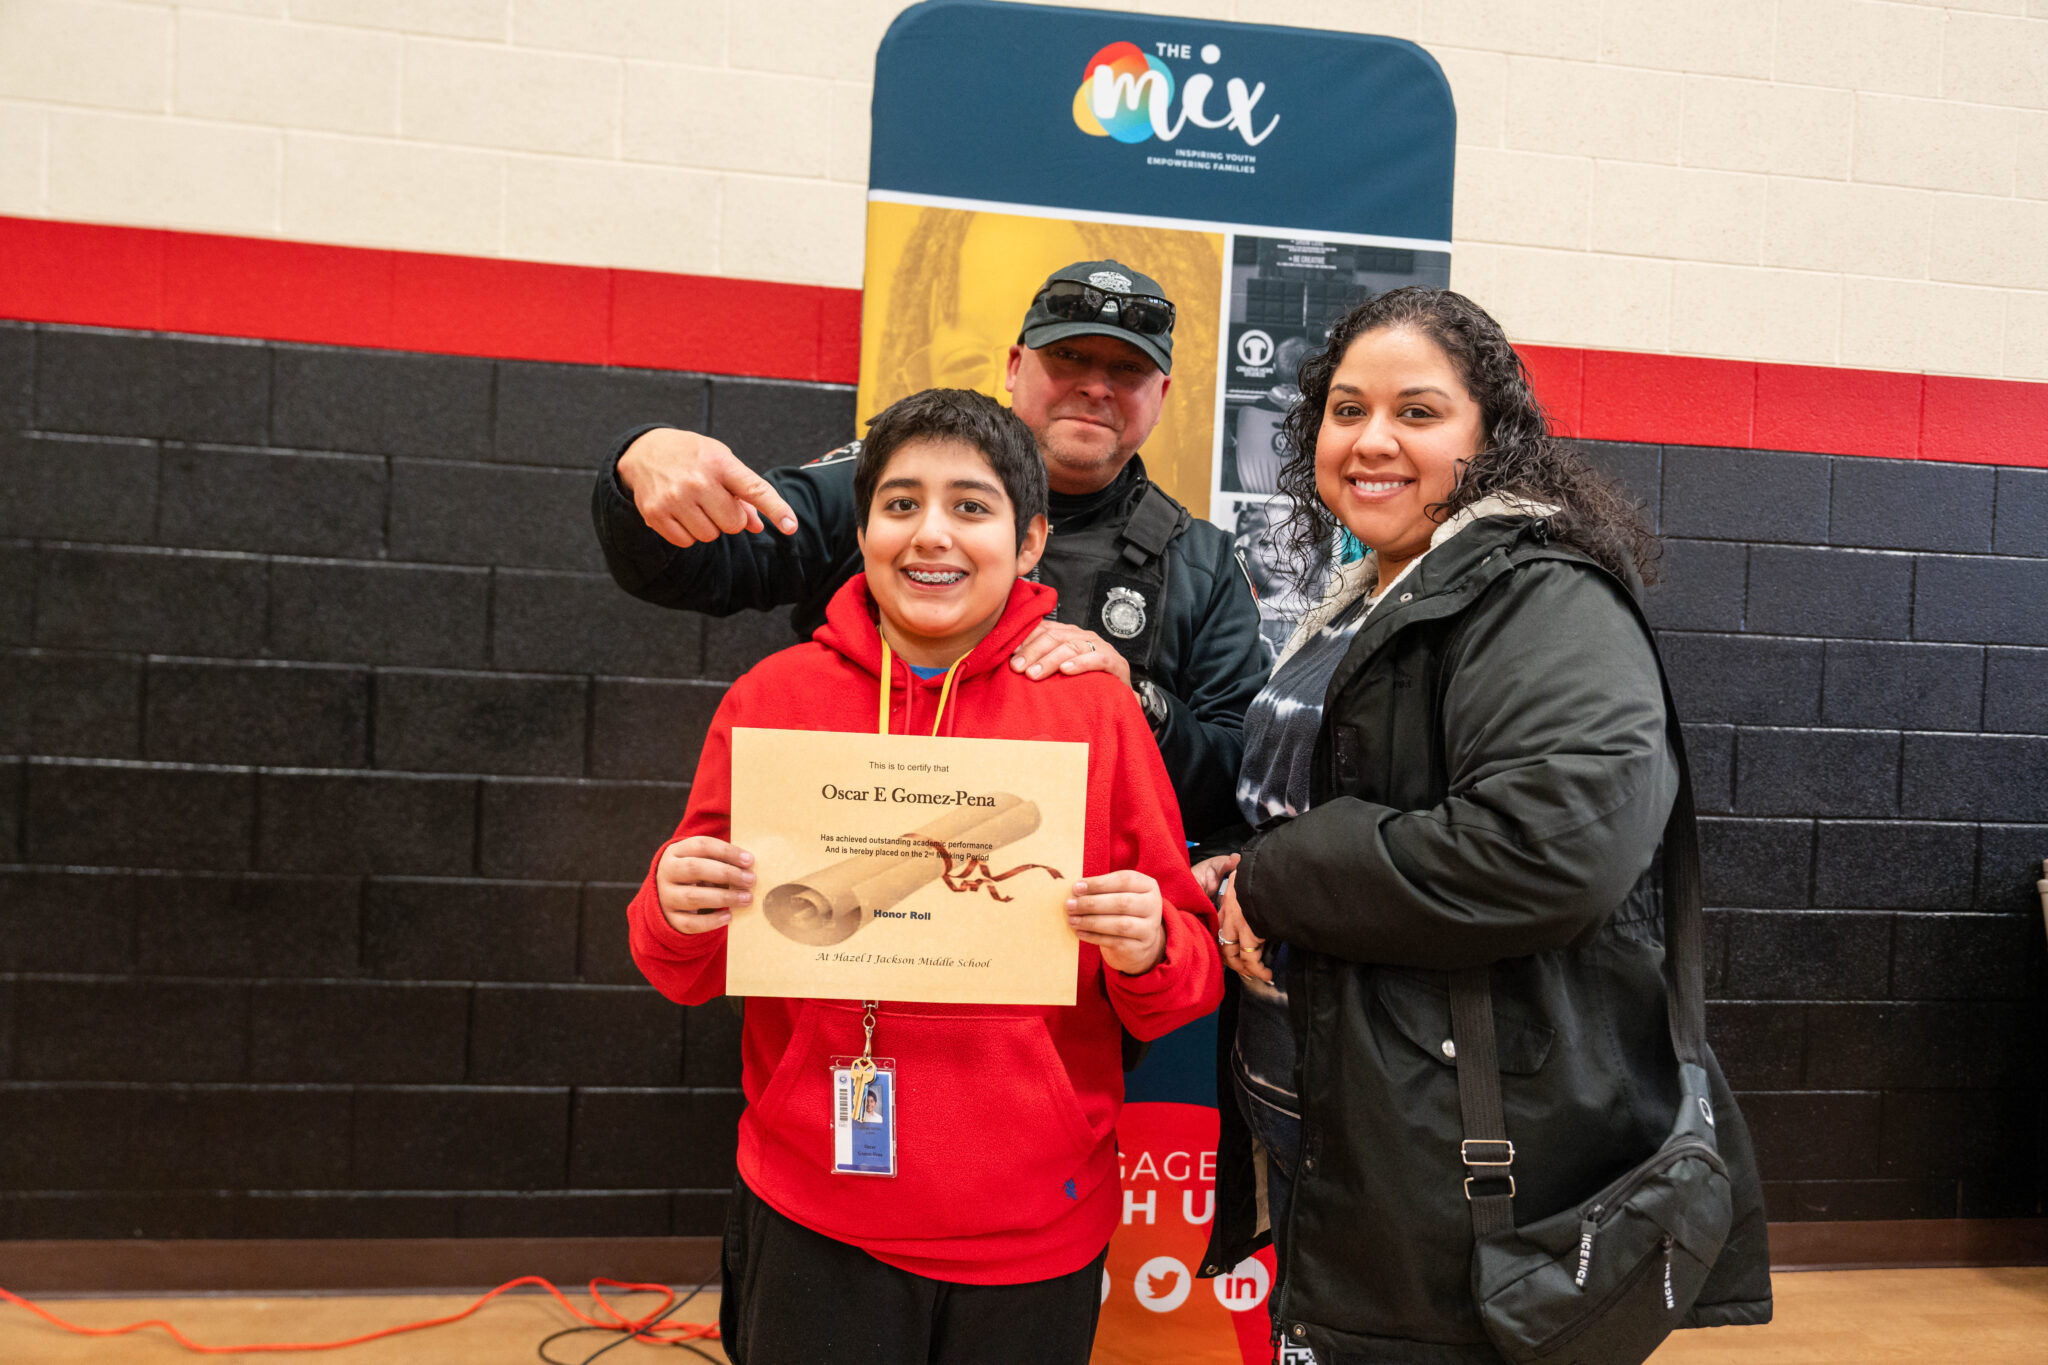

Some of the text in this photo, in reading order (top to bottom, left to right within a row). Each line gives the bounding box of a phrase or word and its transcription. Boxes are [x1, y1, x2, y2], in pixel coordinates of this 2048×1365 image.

[1156, 42, 1192, 60] THE
[1093, 44, 1281, 146] mix
[1175, 149, 1256, 163] INSPIRING YOUTH
[1147, 157, 1256, 174] EMPOWERING FAMILIES
[869, 761, 886, 770] This
[897, 763, 905, 771] to
[907, 764, 931, 773] certify
[822, 784, 996, 807] Oscar E Gomez-Pena
[820, 833, 993, 850] Has achieved outstanding academic performance
[825, 846, 840, 854] And
[849, 847, 874, 857] hereby
[875, 849, 899, 857] placed
[911, 850, 923, 858] the
[936, 852, 965, 862] Mking
[966, 853, 990, 861] Period
[873, 909, 931, 921] Honor Roll
[816, 952, 993, 968] At Hazel I Jackson Middle School
